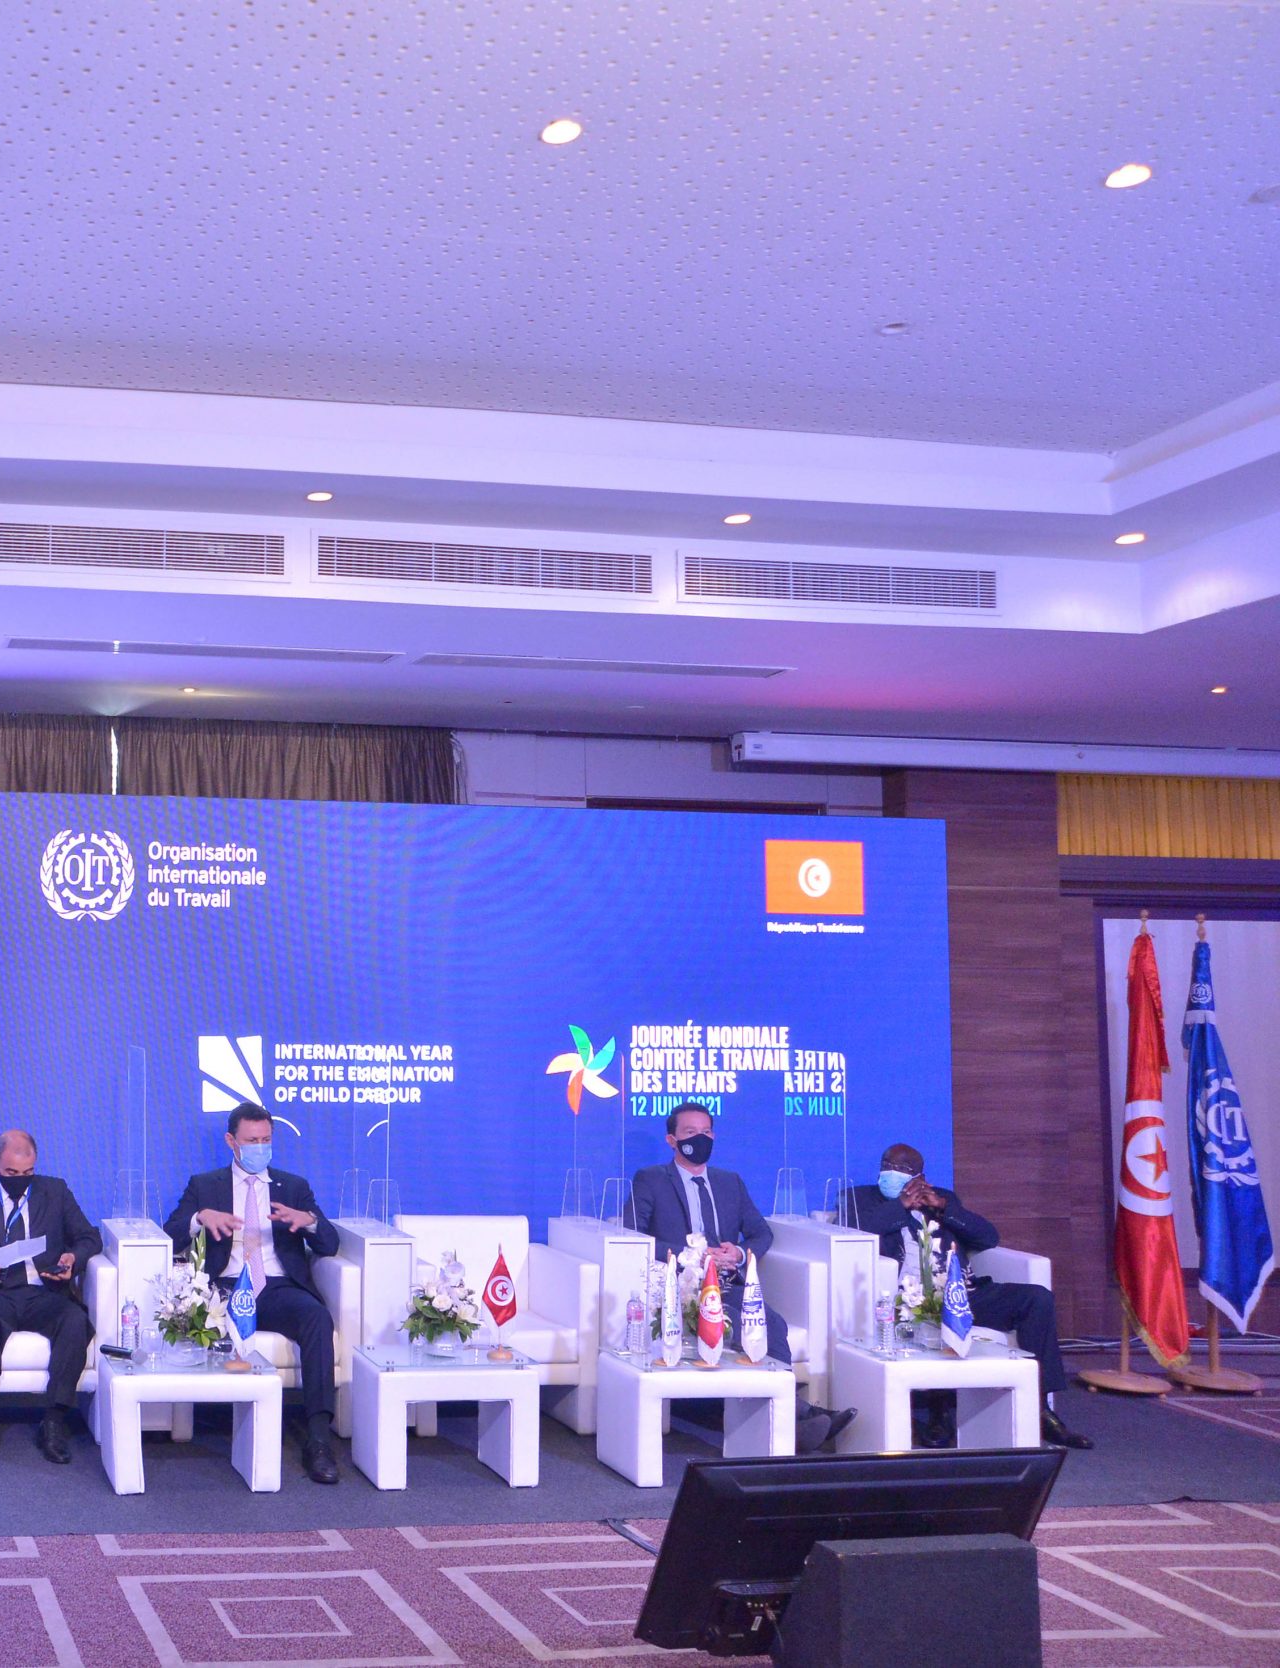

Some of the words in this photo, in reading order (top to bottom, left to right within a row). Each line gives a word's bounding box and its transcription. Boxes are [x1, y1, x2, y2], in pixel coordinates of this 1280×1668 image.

[148, 841, 257, 864] Organisation
[64, 849, 109, 891] OIT
[148, 864, 267, 885] internationale
[148, 888, 169, 906] du
[174, 888, 230, 907] Travail
[630, 1020, 702, 1048] JOURNÉE
[707, 1026, 789, 1048] MONDIALE
[410, 1045, 453, 1061] YEAR
[630, 1049, 695, 1070] CONTRE
[699, 1049, 717, 1070] LE
[275, 1065, 308, 1081] FOR
[312, 1066, 344, 1082] THE
[631, 1072, 662, 1093] DES
[667, 1072, 737, 1093] ENFANTS
[275, 1086, 297, 1102] OF
[300, 1087, 350, 1102] CHILD
[631, 1096, 646, 1116] 12
